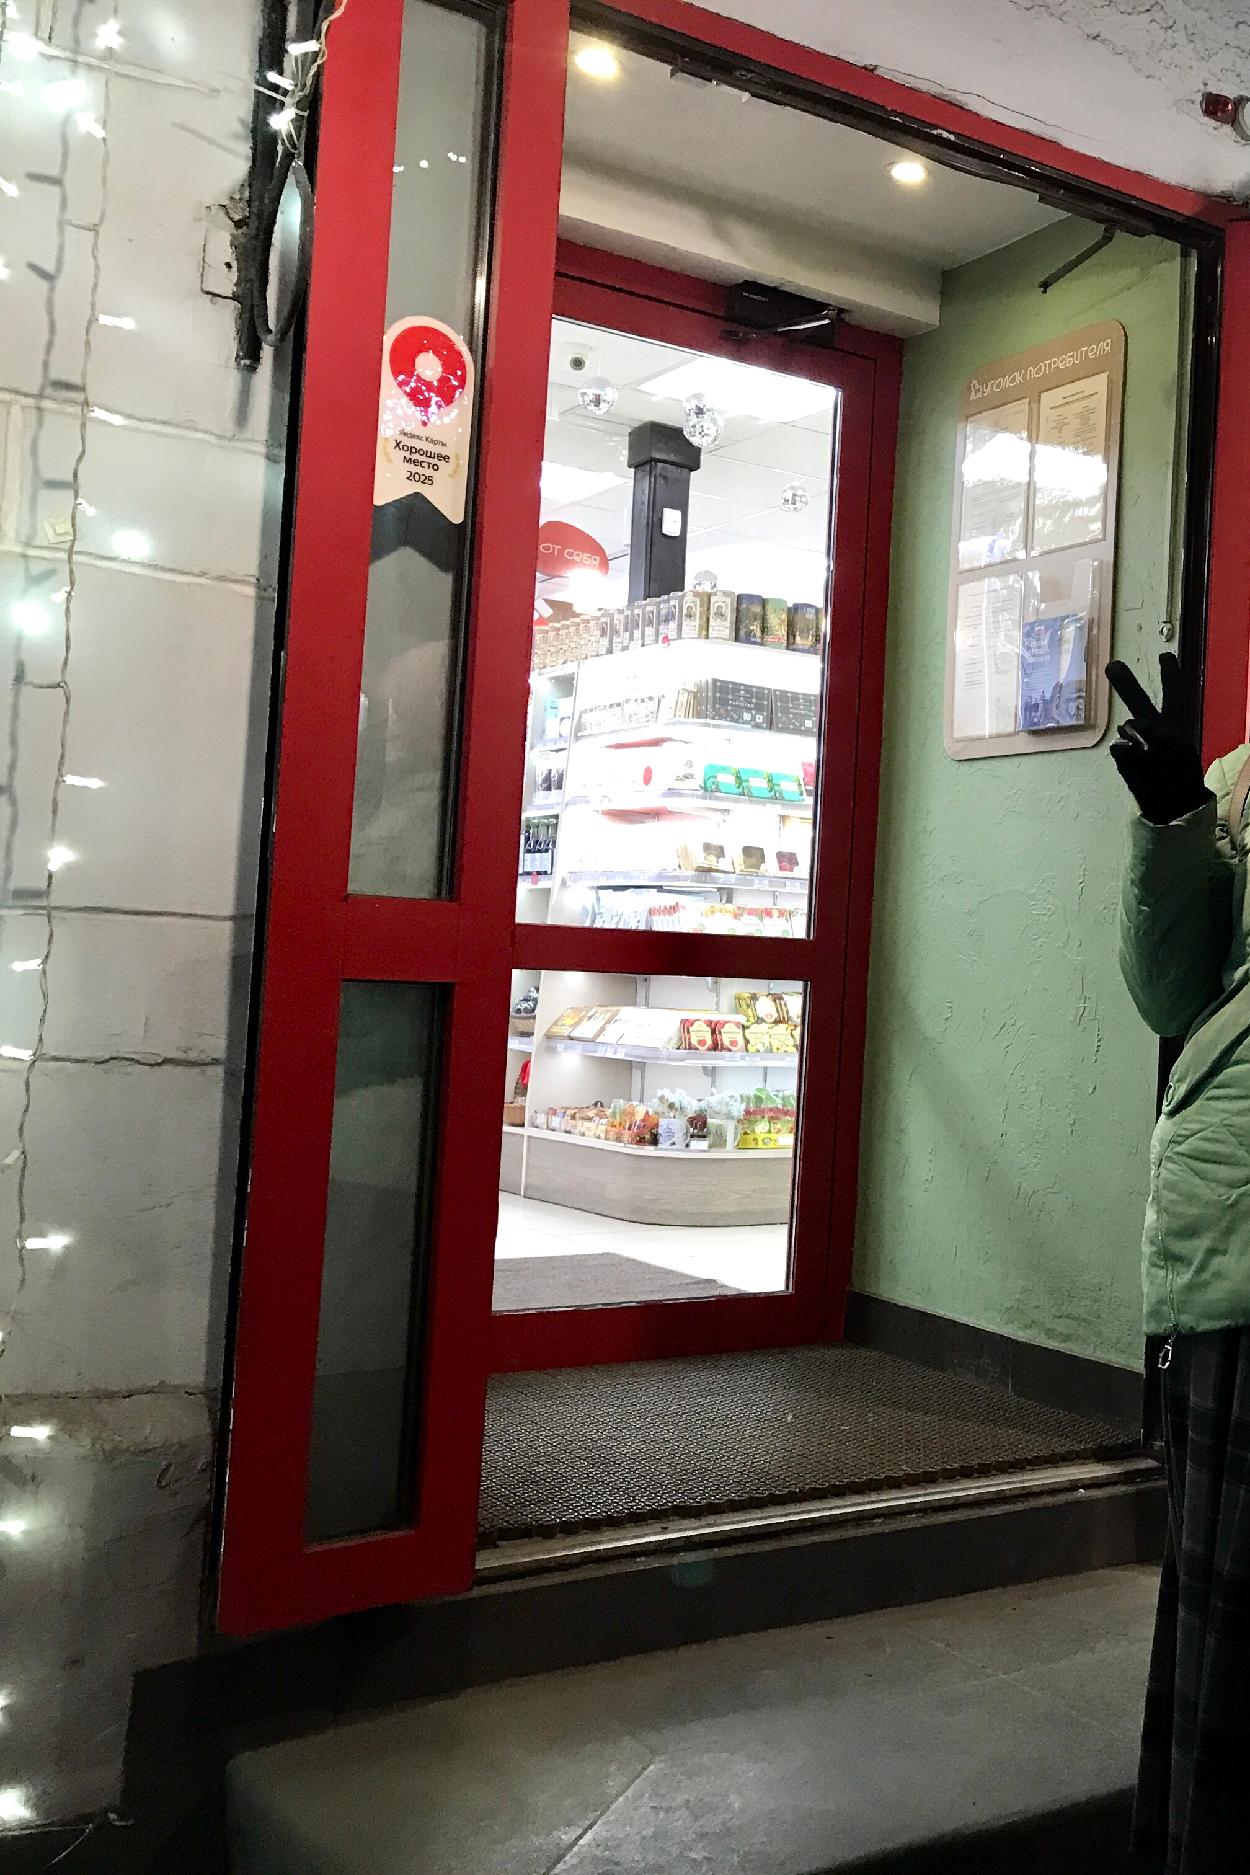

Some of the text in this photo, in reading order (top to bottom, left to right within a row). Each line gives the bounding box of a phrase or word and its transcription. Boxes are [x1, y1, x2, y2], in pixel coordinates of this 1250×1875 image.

[393, 439, 451, 463] Хорошее
[402, 455, 440, 472] место
[406, 470, 434, 486] 2025
